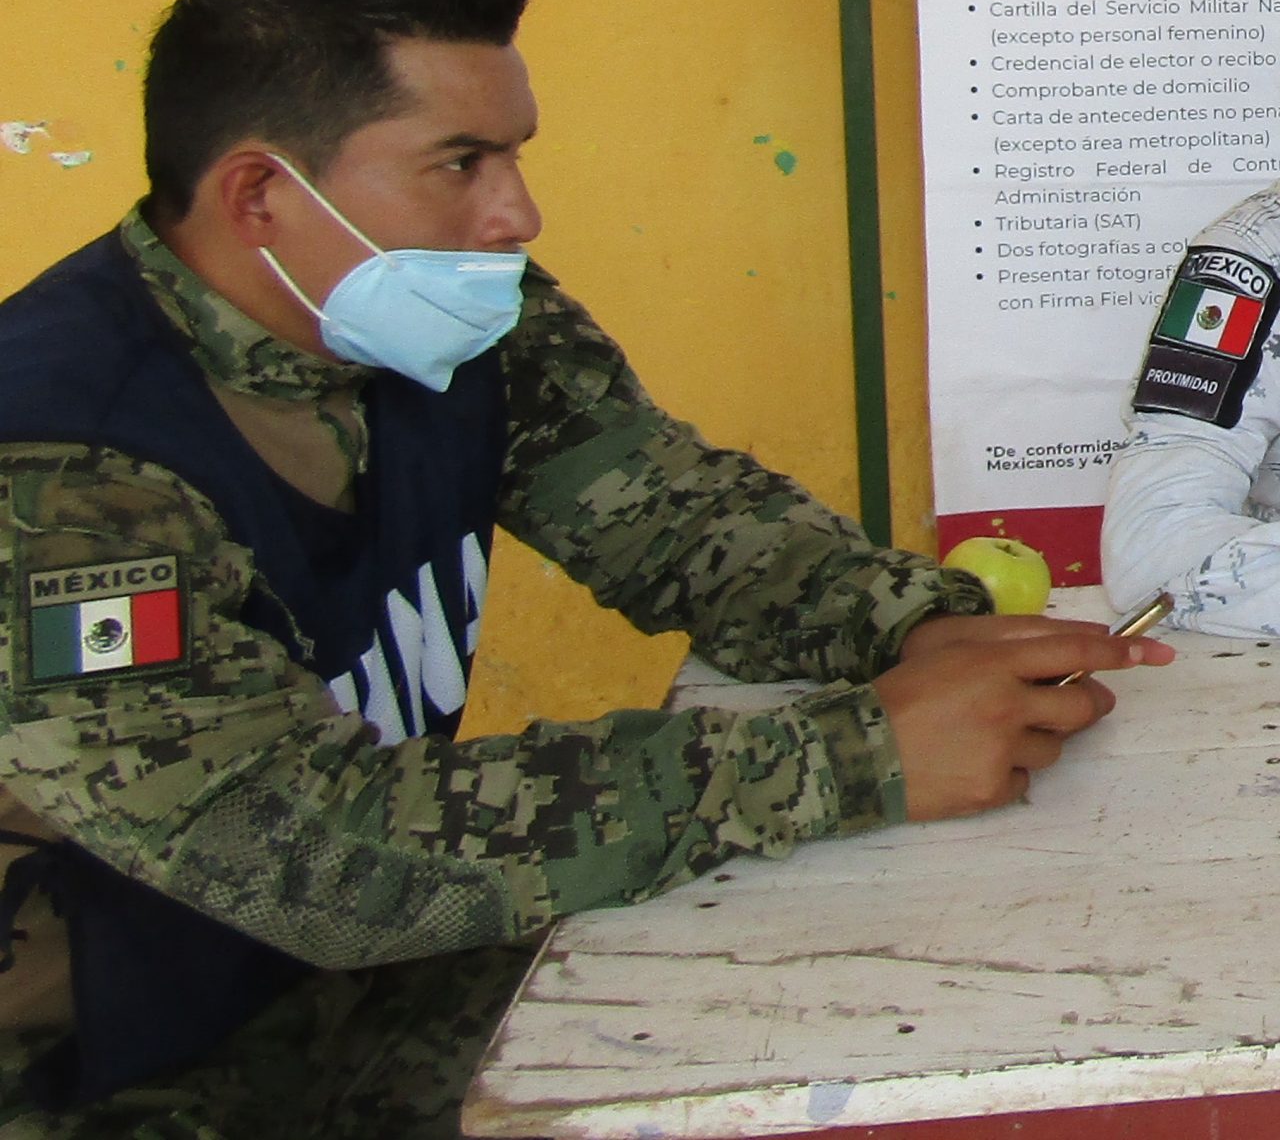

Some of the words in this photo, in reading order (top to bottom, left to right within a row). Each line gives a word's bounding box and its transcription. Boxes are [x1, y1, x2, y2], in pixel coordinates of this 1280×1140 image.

[994, 187, 1141, 205] Administración
[1146, 368, 1219, 395] PROXIMIDAD
[1026, 439, 1121, 457] conformida
[987, 457, 1075, 471] Mexicanos
[1078, 457, 1089, 469] y
[1092, 453, 1113, 465] 47
[34, 563, 172, 598] MÉXICO
